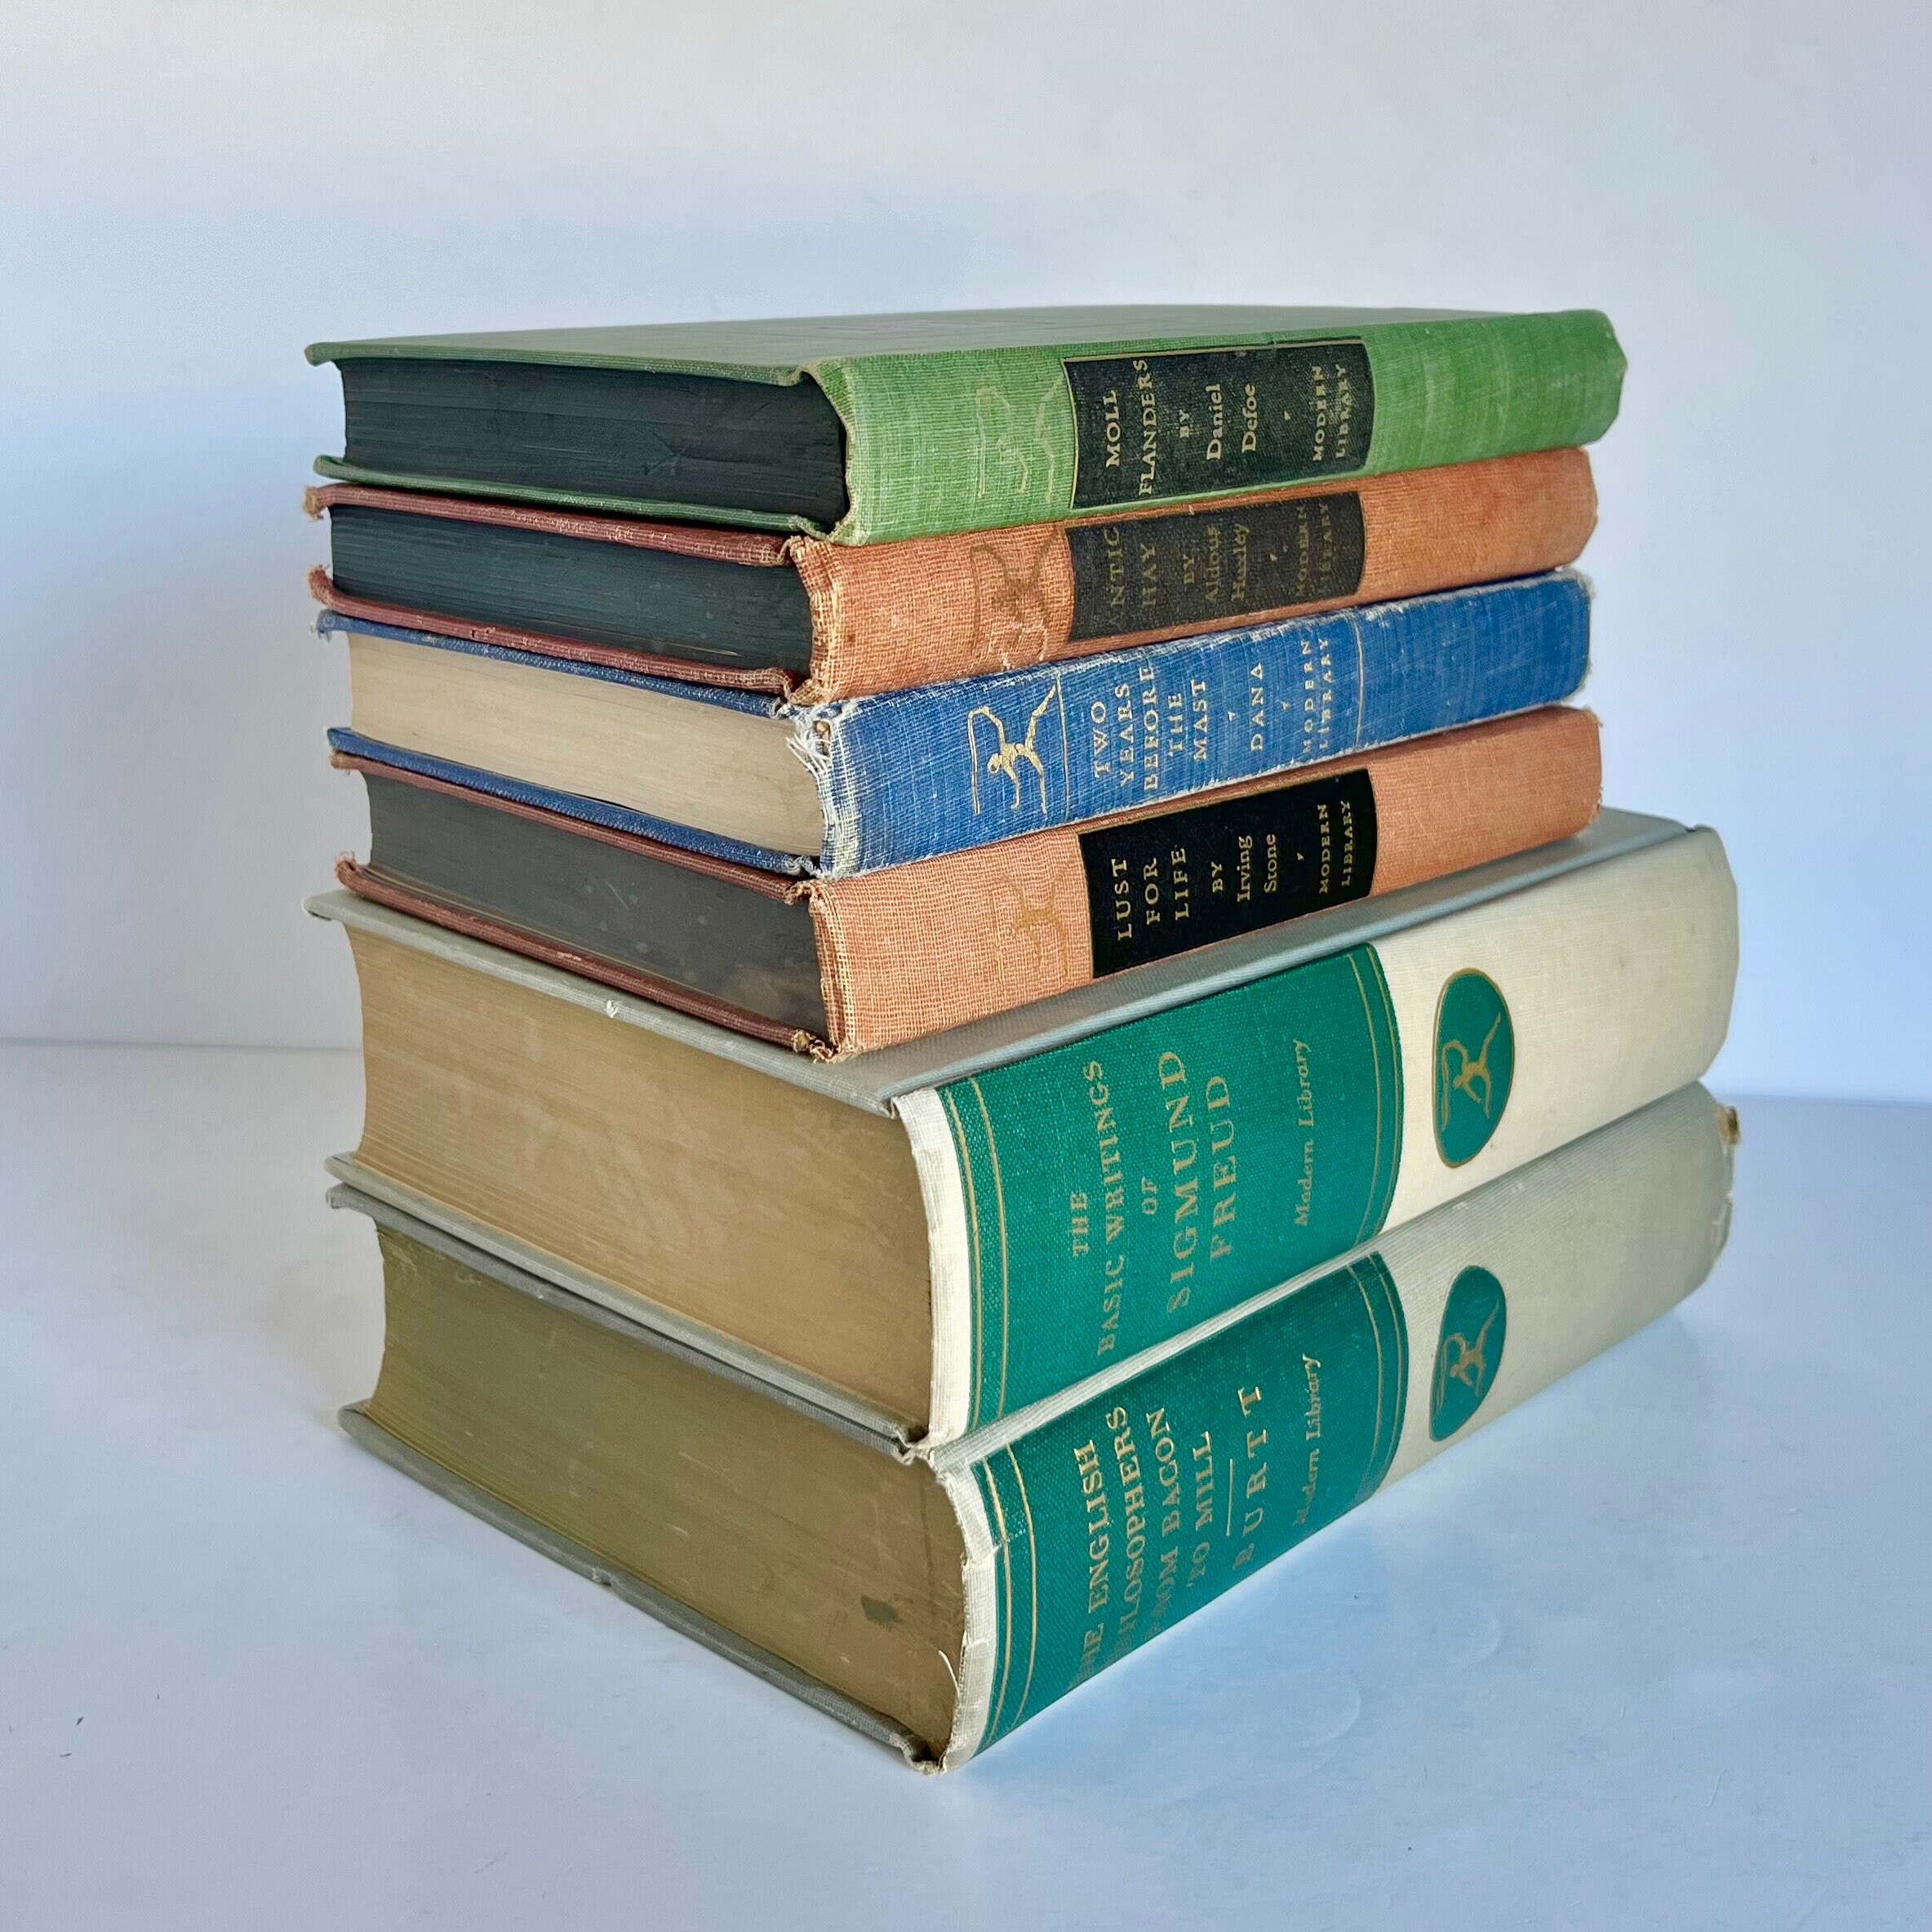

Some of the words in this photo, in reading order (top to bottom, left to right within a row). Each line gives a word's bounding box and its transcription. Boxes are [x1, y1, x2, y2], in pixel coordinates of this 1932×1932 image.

[1104, 389, 1122, 468] MOLL
[1134, 359, 1158, 495] FLANDERS
[1179, 409, 1191, 438] BY
[1206, 384, 1223, 460] Daniel
[1241, 384, 1258, 452] Defoe
[1311, 366, 1327, 461] MODERN
[1335, 364, 1352, 458] LIBRARY
[1184, 553, 1195, 584] BY
[1206, 523, 1221, 605] Aldous
[1231, 522, 1250, 602] Huxley
[1116, 682, 1135, 787] YEARS
[1139, 667, 1160, 790] BEFORE
[1167, 693, 1184, 757] THE
[1191, 679, 1208, 762] MAST
[1250, 662, 1265, 752] DANA
[1300, 641, 1317, 753] MODERN
[1319, 638, 1334, 749] LIBRARY
[1090, 700, 1111, 779] TWO
[1171, 847, 1189, 922] LIFE
[1210, 860, 1224, 893] BY
[1237, 835, 1253, 902] Irving
[1264, 833, 1278, 893] Stone
[1317, 804, 1331, 894] MODERN
[1341, 801, 1353, 887] LIBRARY
[1111, 859, 1132, 941] LUST
[1143, 857, 1161, 926] FOR
[1293, 1038, 1314, 1128] Library
[1083, 1060, 1125, 1244] WRITINGS
[1141, 1175, 1158, 1215] OF
[1157, 1050, 1200, 1314] SIGMUND
[1206, 1076, 1237, 1262] FREUD
[1295, 1139, 1314, 1227] Modern
[1070, 1191, 1090, 1258] THE
[1097, 1255, 1125, 1356] BASIC
[1302, 1352, 1321, 1441] Library
[1146, 1408, 1181, 1537] BACON
[1193, 1431, 1215, 1532] MILL
[1073, 1439, 1111, 1614] ENGLISH
